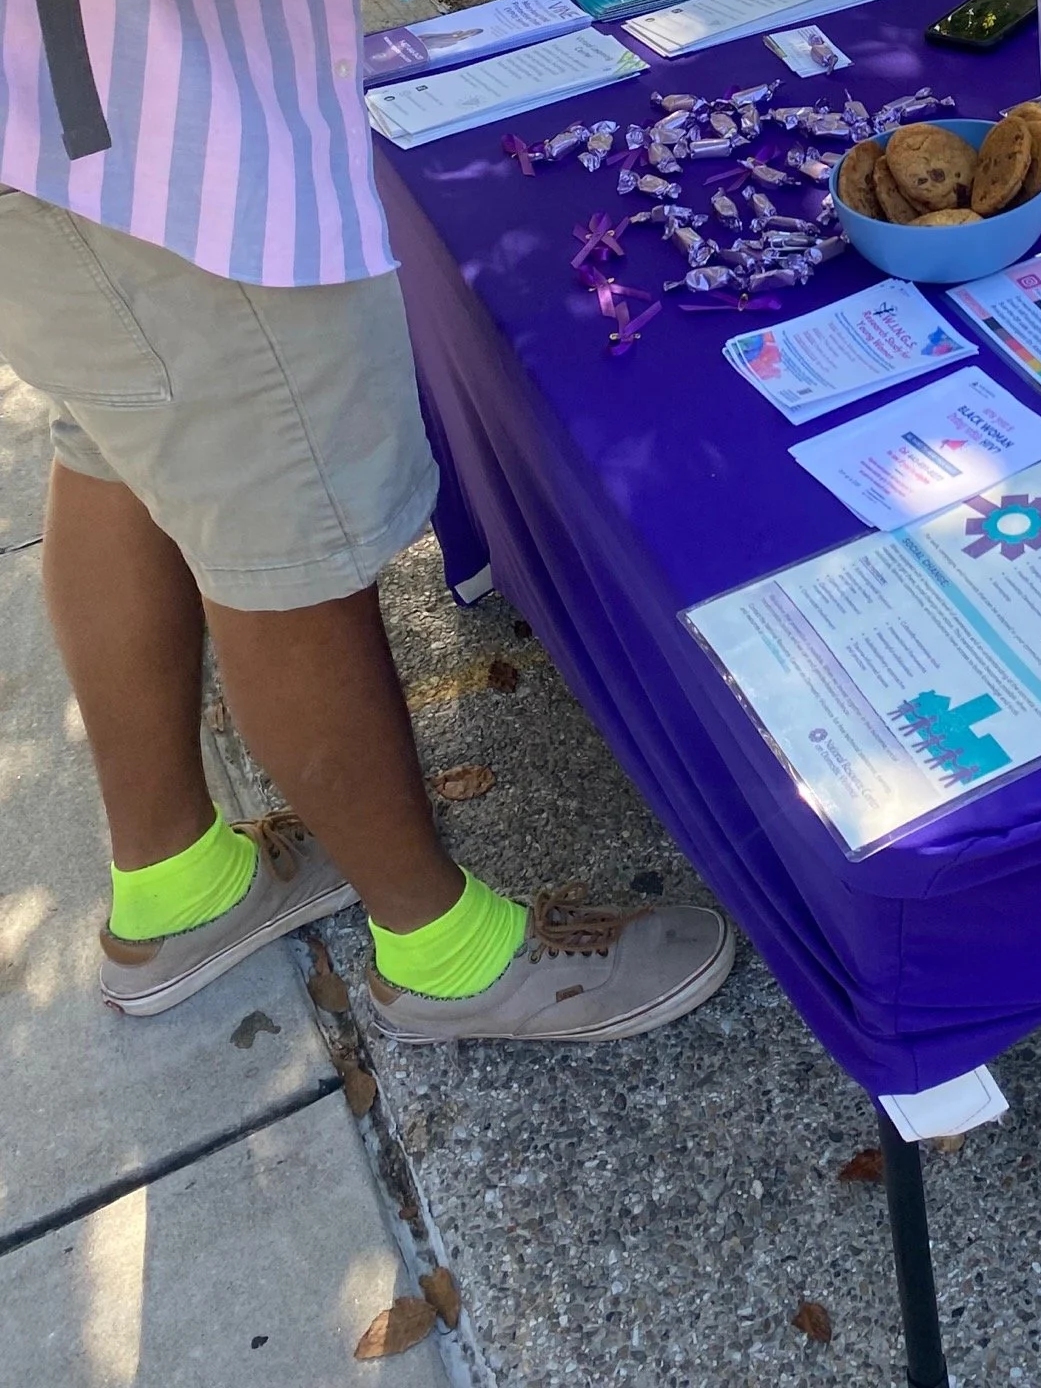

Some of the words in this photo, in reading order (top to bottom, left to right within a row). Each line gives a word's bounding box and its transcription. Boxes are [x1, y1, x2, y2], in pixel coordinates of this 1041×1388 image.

[955, 404, 985, 425] BLACK
[977, 422, 1016, 449] WOMAN
[900, 537, 927, 560] SOCIAL
[919, 558, 953, 589] CHANGE:
[823, 737, 848, 764] National
